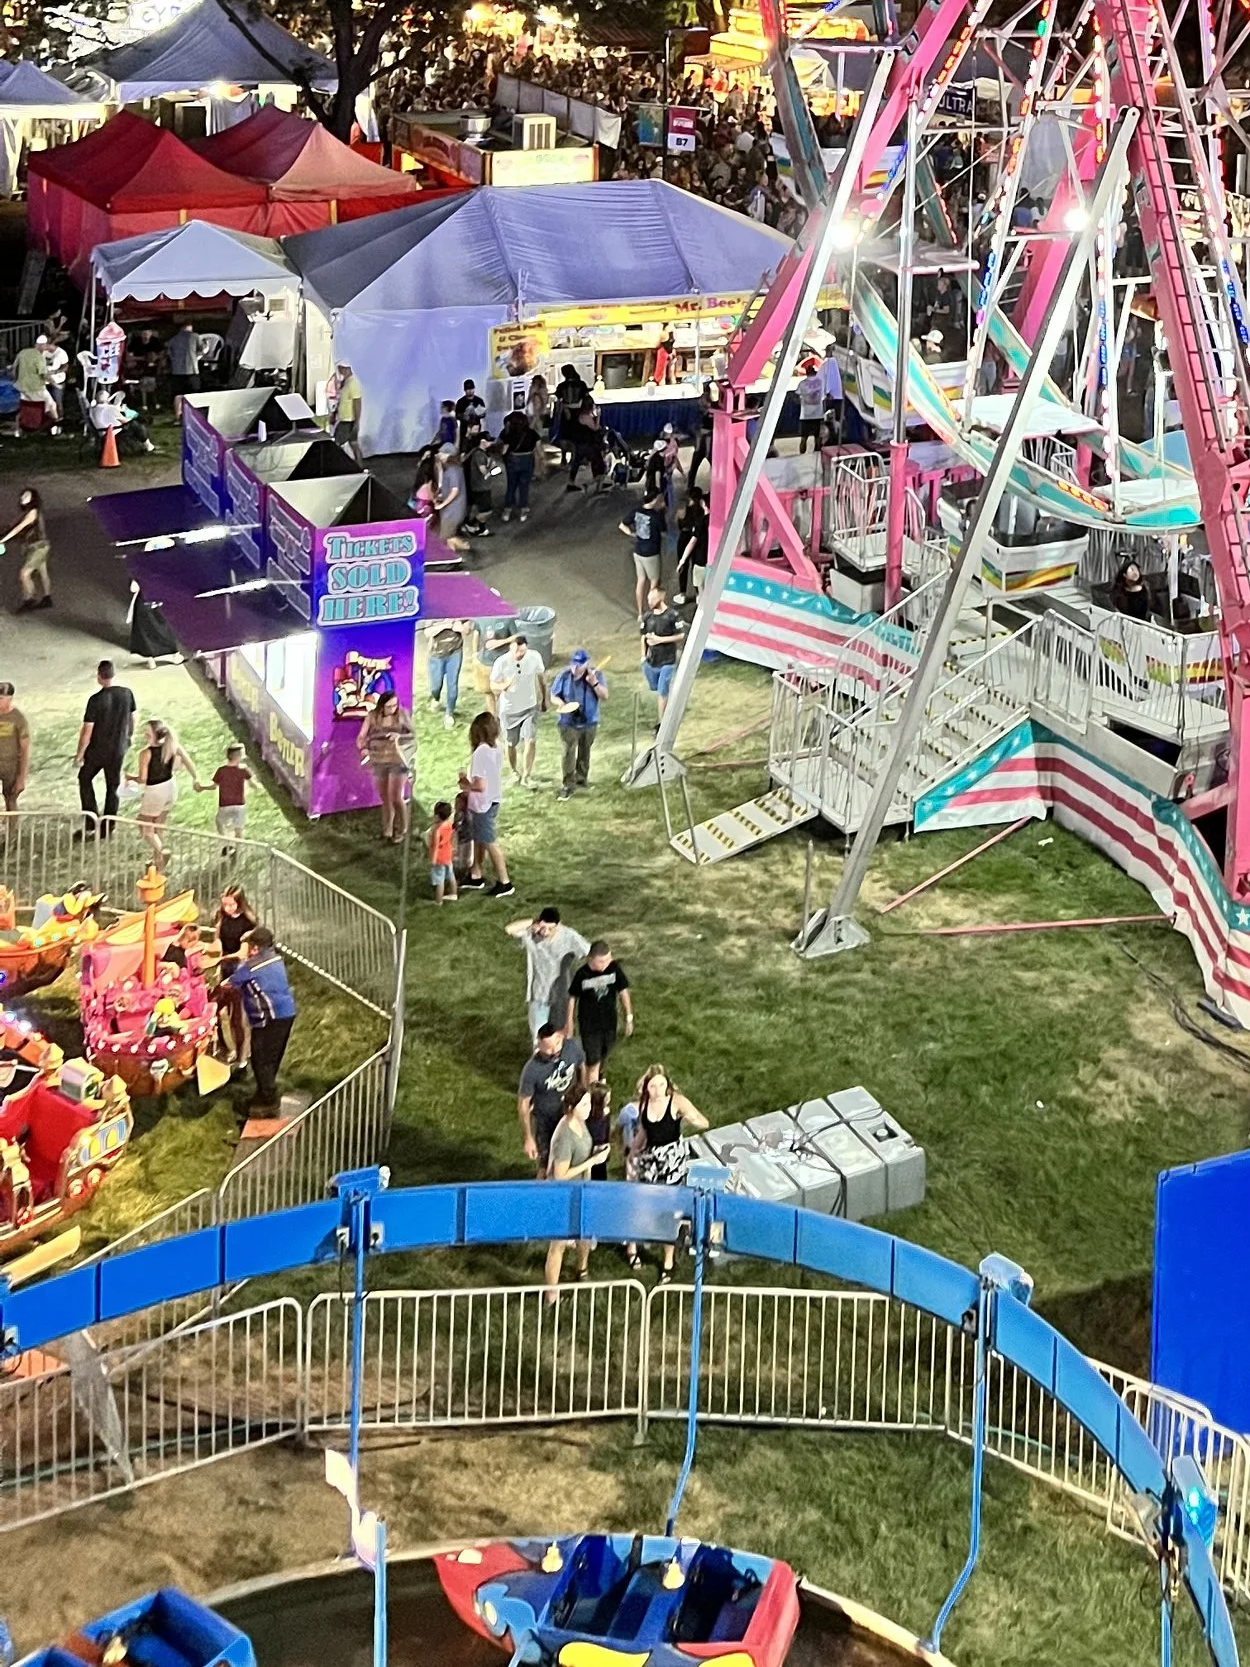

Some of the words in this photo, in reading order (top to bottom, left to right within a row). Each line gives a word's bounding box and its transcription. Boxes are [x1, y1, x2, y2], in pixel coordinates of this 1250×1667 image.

[675, 137, 689, 147] B7
[331, 561, 409, 591] SOLD
[321, 589, 417, 622] HERE!
